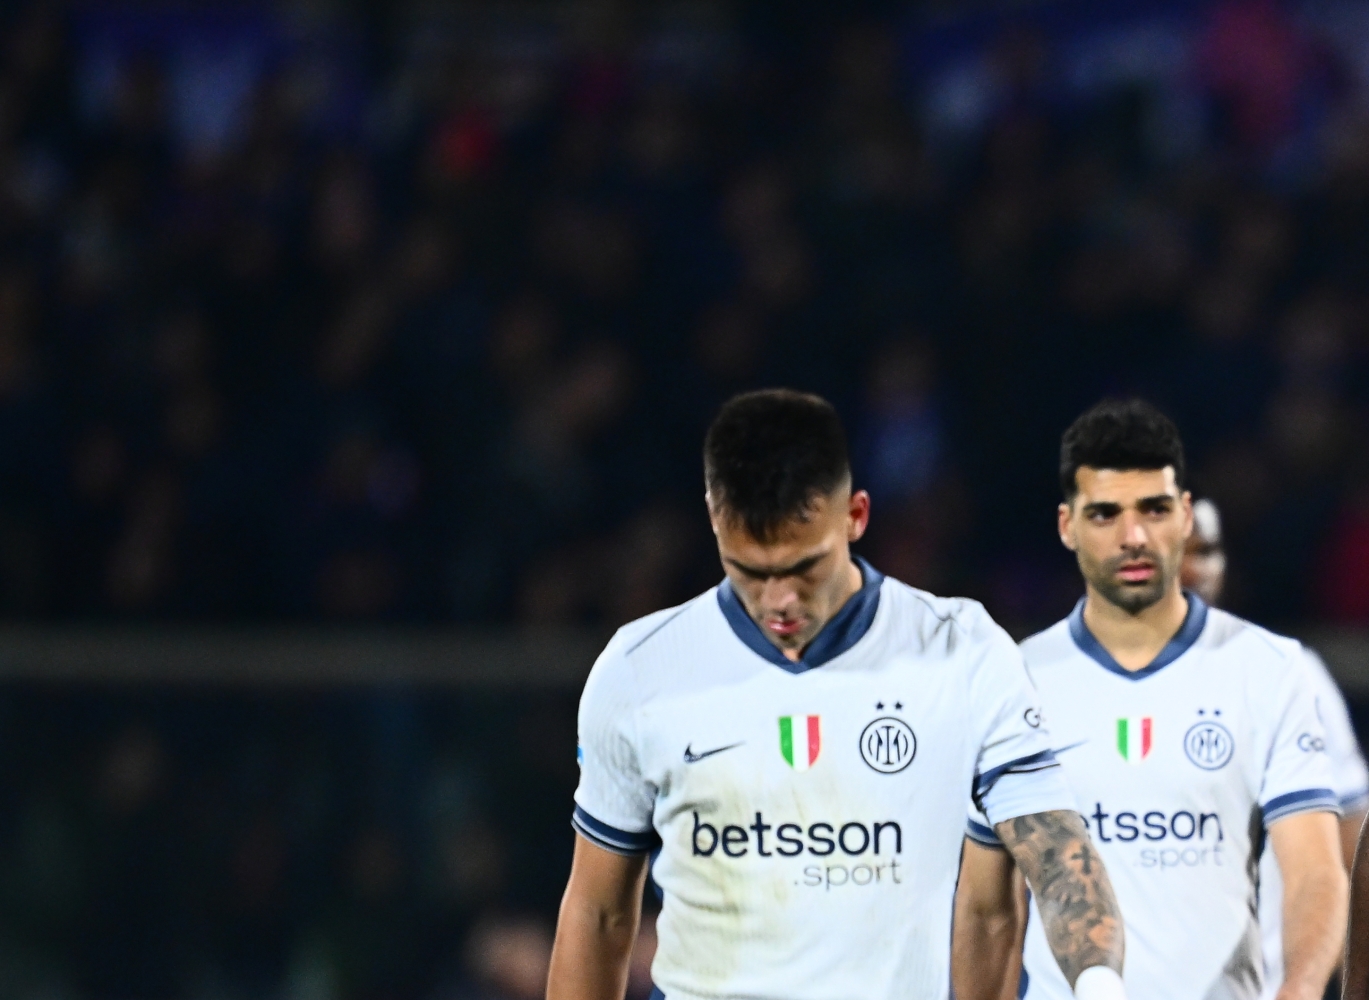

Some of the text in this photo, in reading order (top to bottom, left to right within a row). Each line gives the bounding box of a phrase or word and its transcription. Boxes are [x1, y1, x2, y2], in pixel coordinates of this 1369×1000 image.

[692, 810, 903, 858] betsson
[1080, 801, 1224, 842] tsson
[793, 859, 903, 892] .sport
